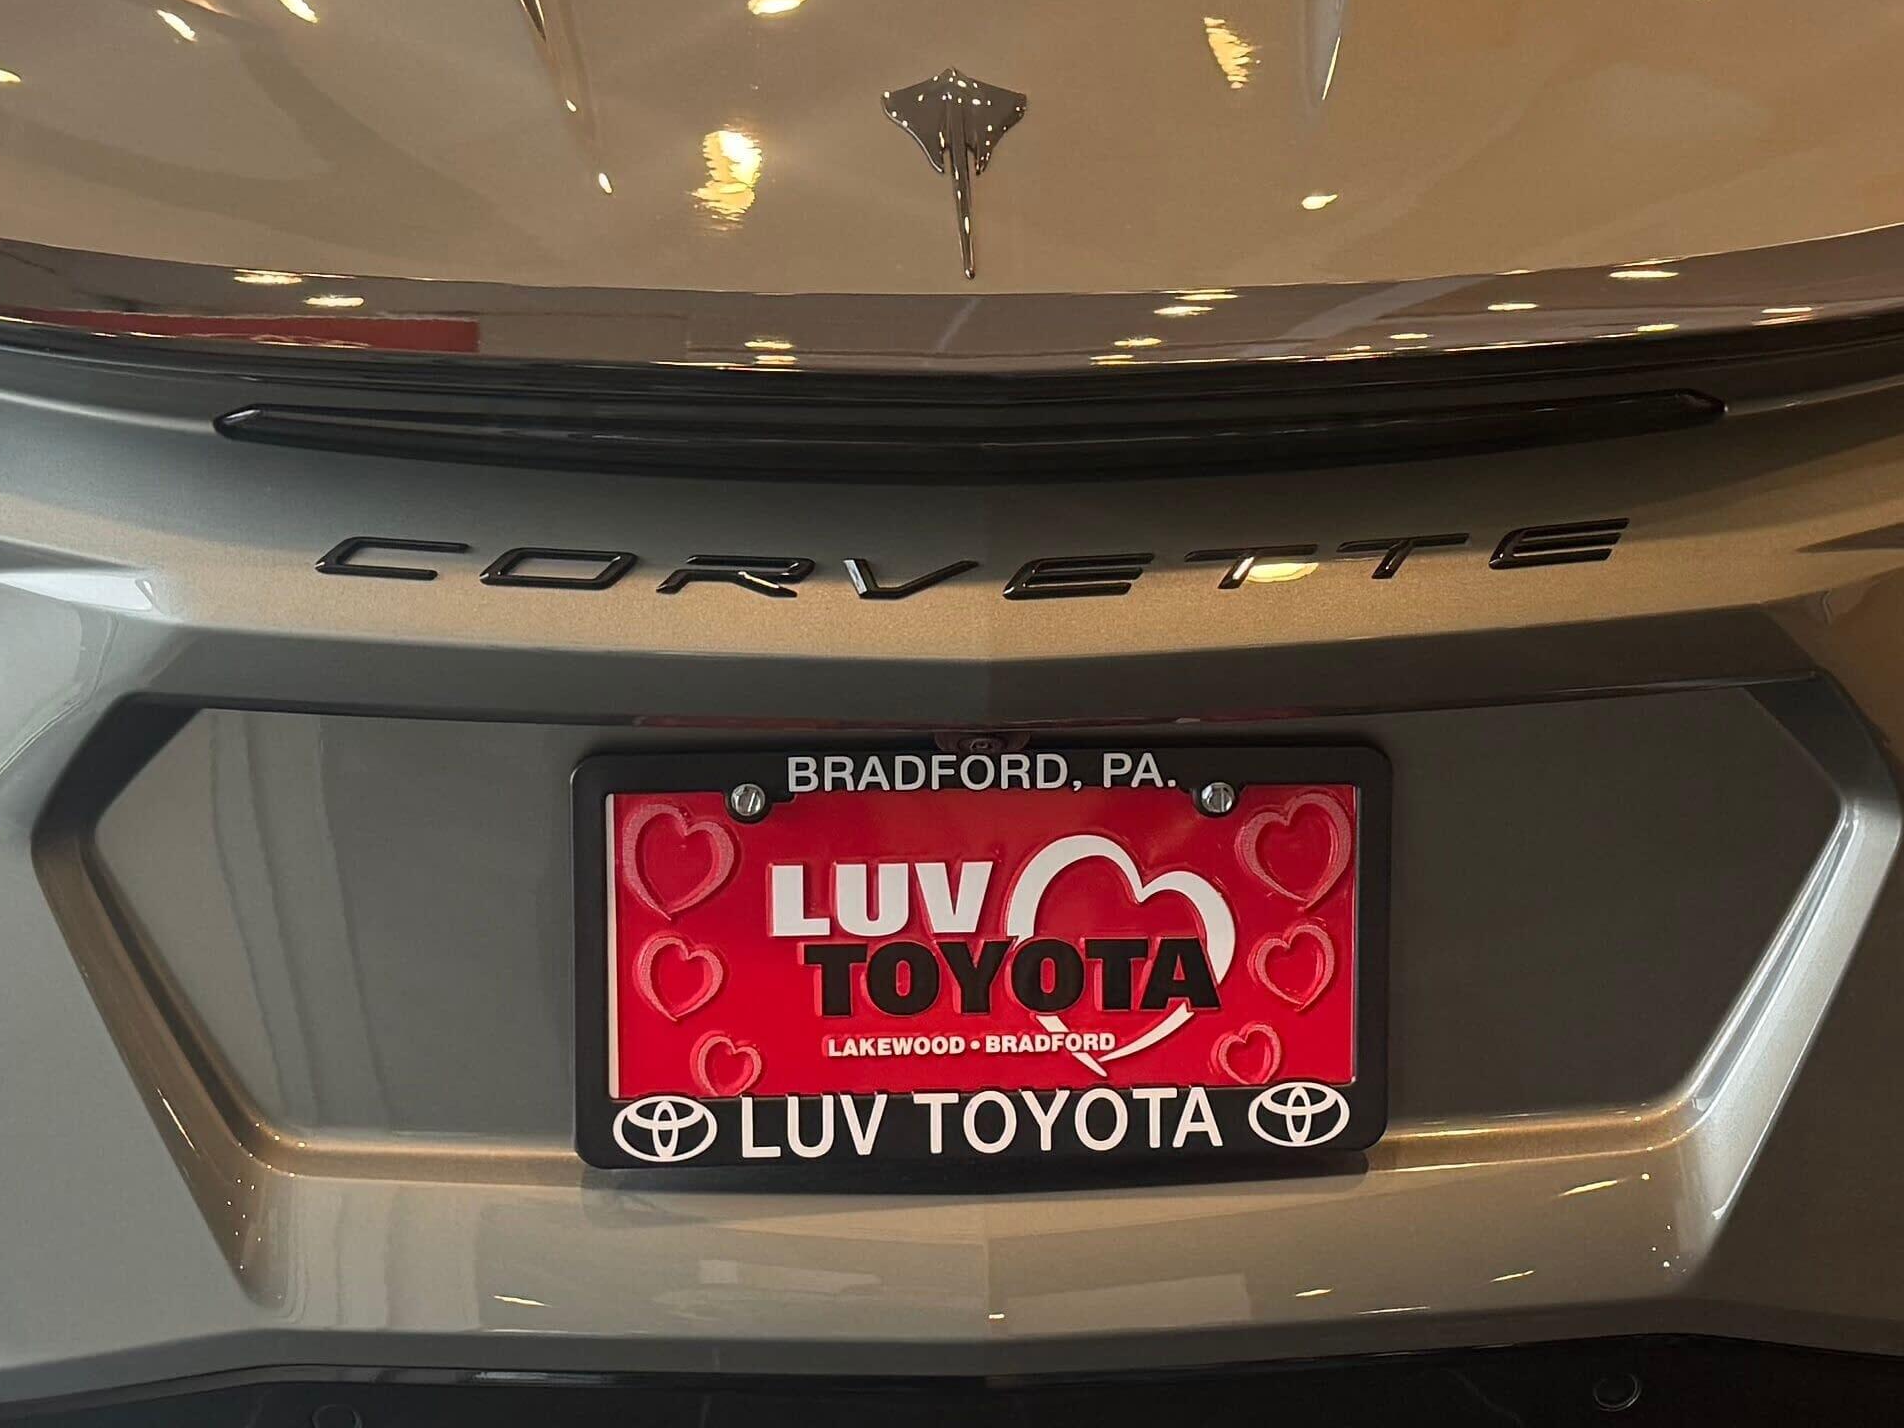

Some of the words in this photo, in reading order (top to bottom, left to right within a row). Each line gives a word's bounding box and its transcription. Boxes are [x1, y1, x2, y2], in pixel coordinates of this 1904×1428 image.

[314, 517, 1632, 601] CORVETTE
[787, 753, 1082, 793] BRADFORD,
[1103, 751, 1178, 790] PA.
[771, 861, 994, 938] LUV
[804, 937, 1222, 1017] TOYOTA
[827, 1035, 966, 1058] LAKEWOOD
[985, 1032, 1116, 1054] BRADFORD
[741, 1093, 889, 1159] LUV
[913, 1086, 1223, 1155] TOYOTA
